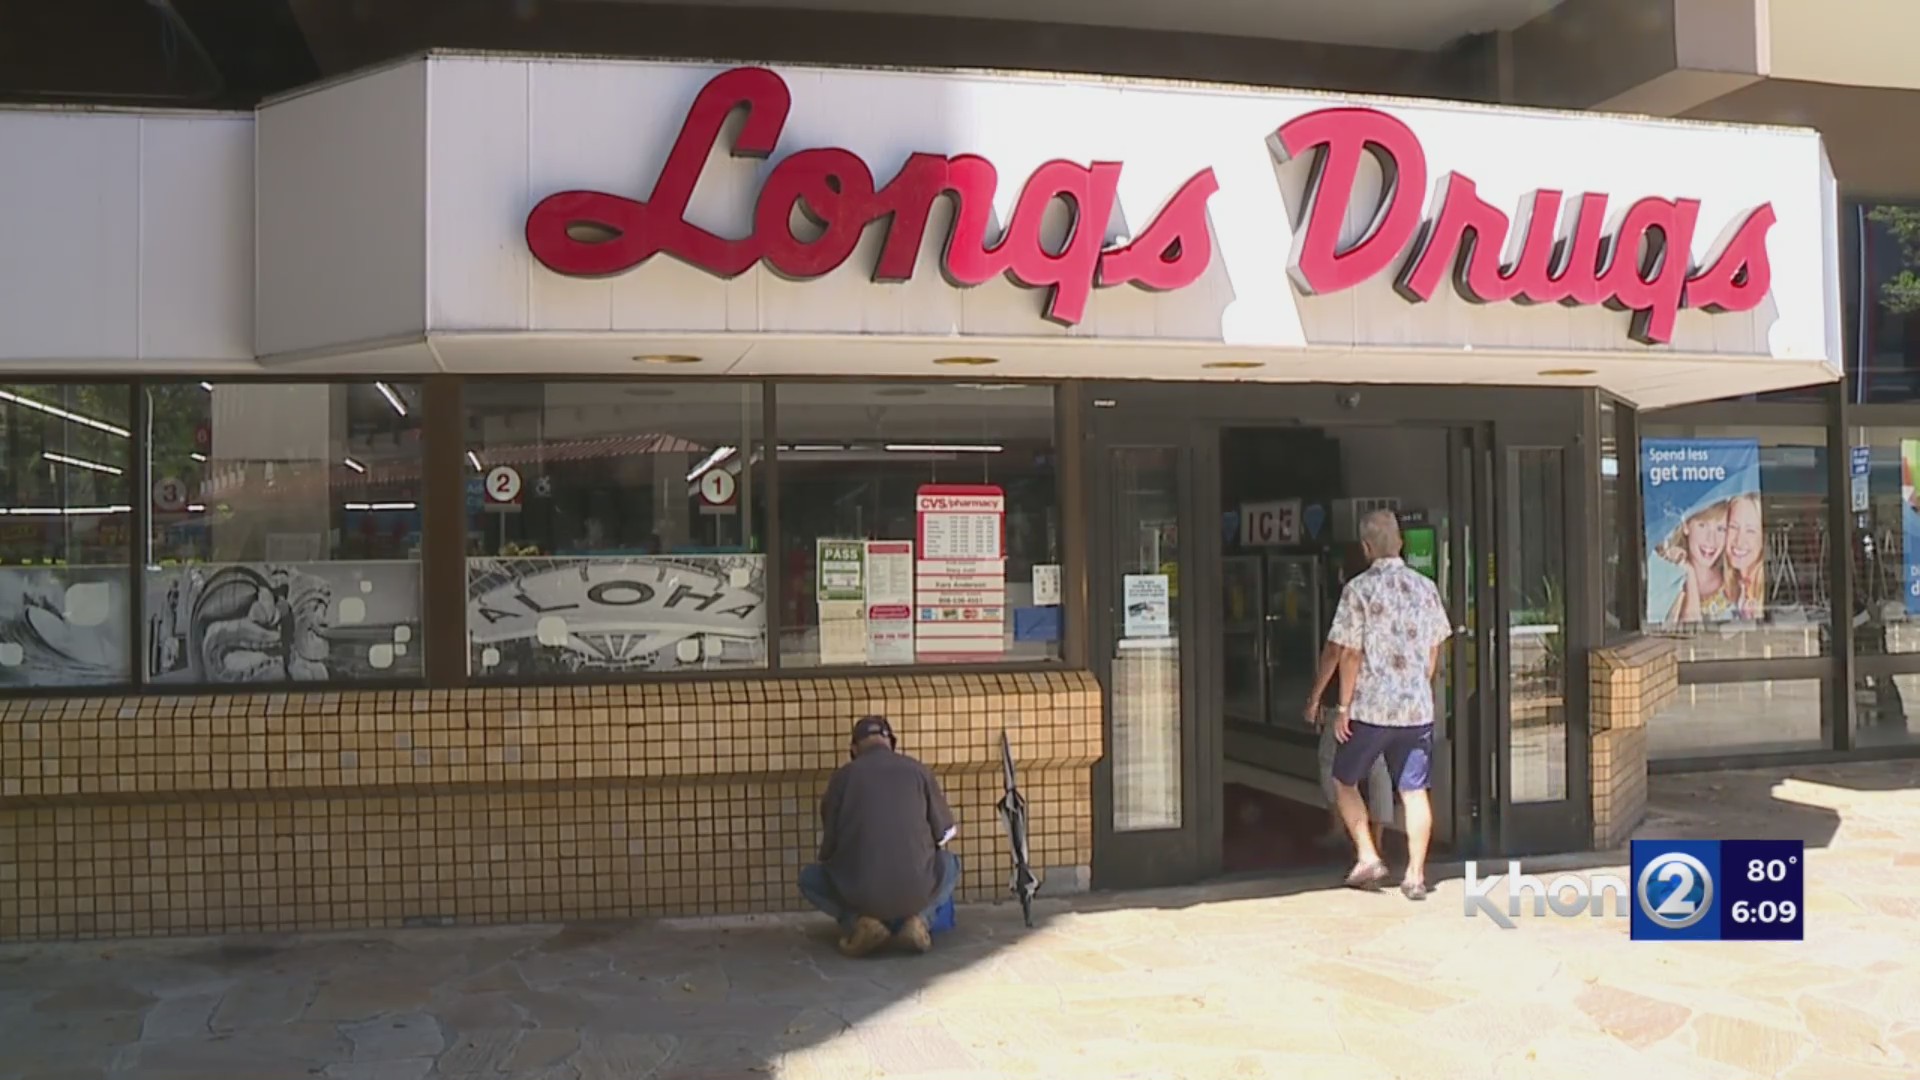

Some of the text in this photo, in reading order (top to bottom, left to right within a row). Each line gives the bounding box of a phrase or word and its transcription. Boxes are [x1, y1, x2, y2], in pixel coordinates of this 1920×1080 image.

[526, 66, 1777, 344] Longs Drugs
[1649, 446, 1708, 464] Spend less
[496, 473, 510, 492] 2
[1649, 464, 1726, 486] get more
[163, 484, 177, 502] 3
[712, 476, 723, 495] 1
[1248, 507, 1292, 544] ICE
[824, 548, 858, 560] PASS
[477, 579, 758, 624] ALOHA
